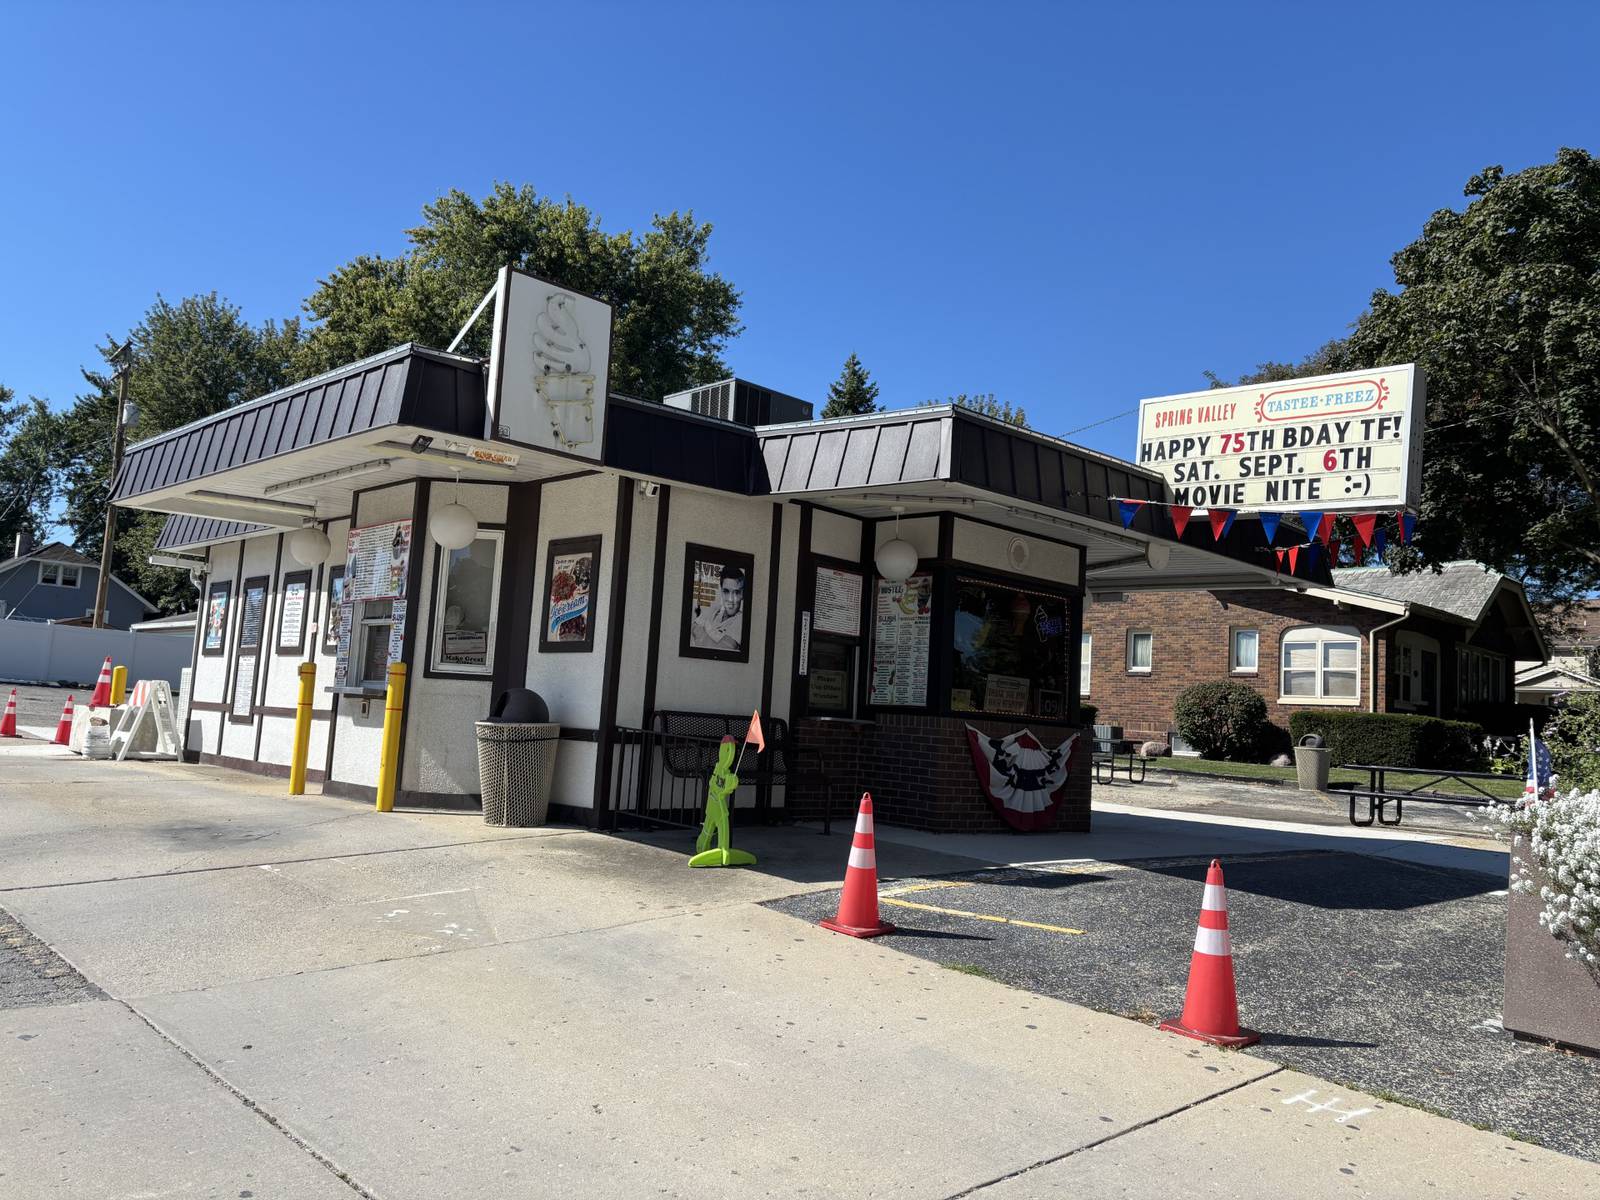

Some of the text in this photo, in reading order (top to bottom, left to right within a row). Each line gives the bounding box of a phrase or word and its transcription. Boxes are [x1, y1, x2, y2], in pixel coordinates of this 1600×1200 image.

[1156, 402, 1237, 428] SPRING VALLEY
[1141, 416, 1402, 462] HAPPY 75TH BDAY TF!
[1174, 447, 1372, 483] SAT. SEPT. 6TH
[1174, 483, 1245, 506] MOVIE
[1266, 478, 1321, 502] NITE
